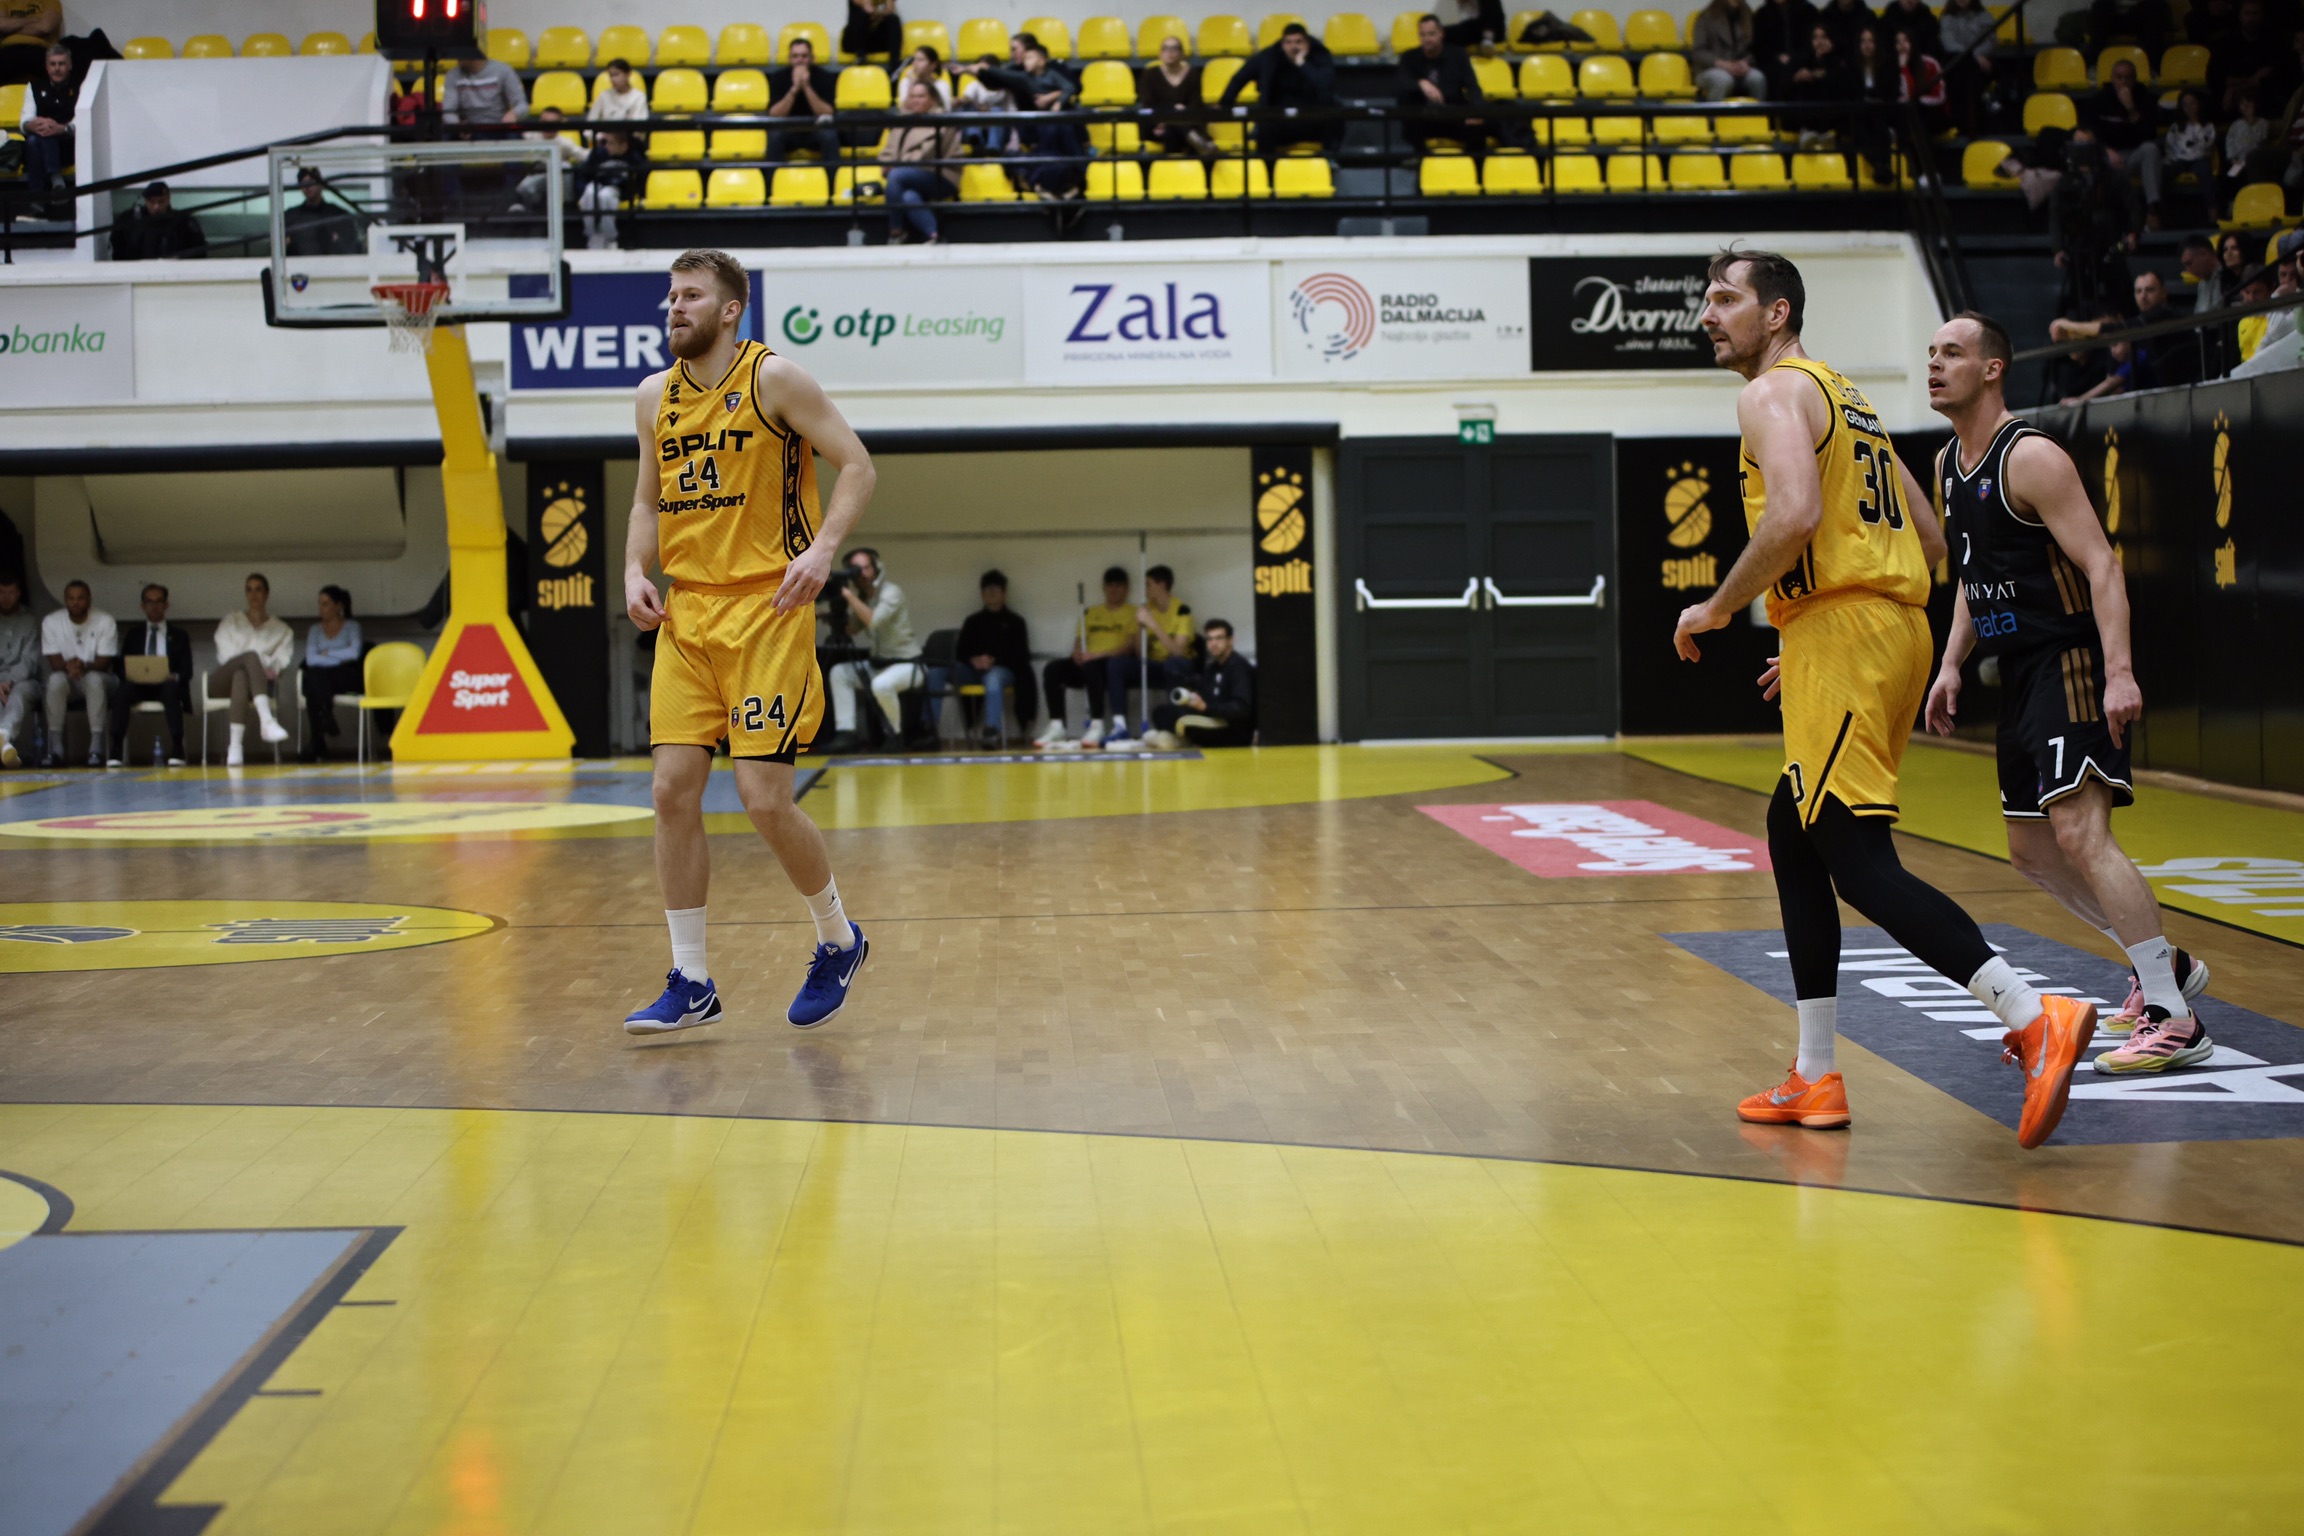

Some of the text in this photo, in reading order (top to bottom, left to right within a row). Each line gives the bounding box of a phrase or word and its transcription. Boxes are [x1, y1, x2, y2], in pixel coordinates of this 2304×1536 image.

[1065, 282, 1228, 342] Zala
[1381, 294, 1438, 307] RADIO
[1381, 309, 1485, 323] DALMACIJA
[833, 308, 1005, 346] otp Leasing
[523, 325, 671, 370] WER
[662, 429, 753, 462] SPLIT
[678, 456, 720, 493] 24
[1854, 439, 1904, 531] 30
[658, 493, 746, 515] SuperSport
[1255, 558, 1312, 597] split
[1661, 552, 1718, 591] split
[537, 571, 595, 611] split
[449, 670, 512, 691] Super
[452, 689, 510, 710] Sport
[743, 694, 786, 732] 24
[2048, 736, 2065, 779] 7
